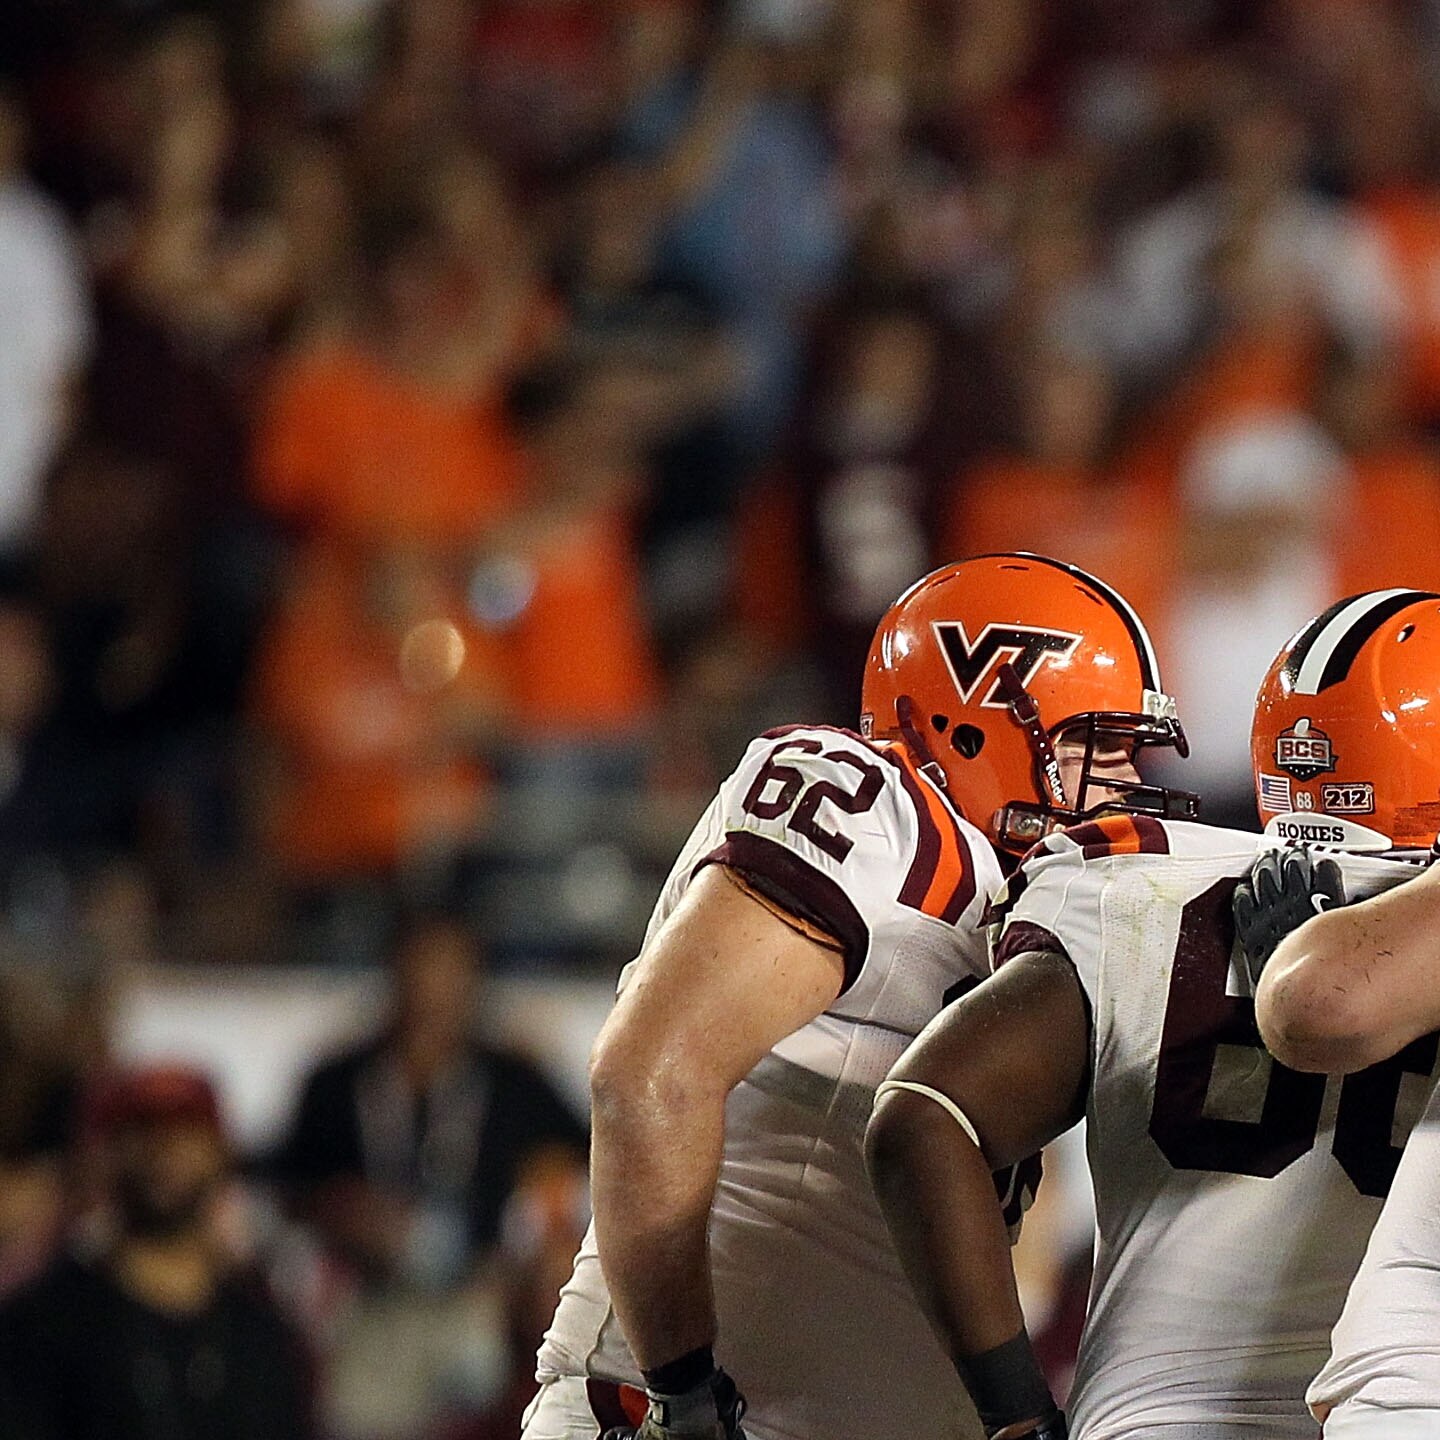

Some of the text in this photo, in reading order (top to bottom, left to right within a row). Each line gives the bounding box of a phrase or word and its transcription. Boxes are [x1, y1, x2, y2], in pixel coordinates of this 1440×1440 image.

[932, 620, 1083, 709] VT
[1280, 740, 1327, 758] BCS
[740, 740, 885, 864] 62
[1296, 791, 1312, 809] 68
[1277, 822, 1345, 842] HOKIES
